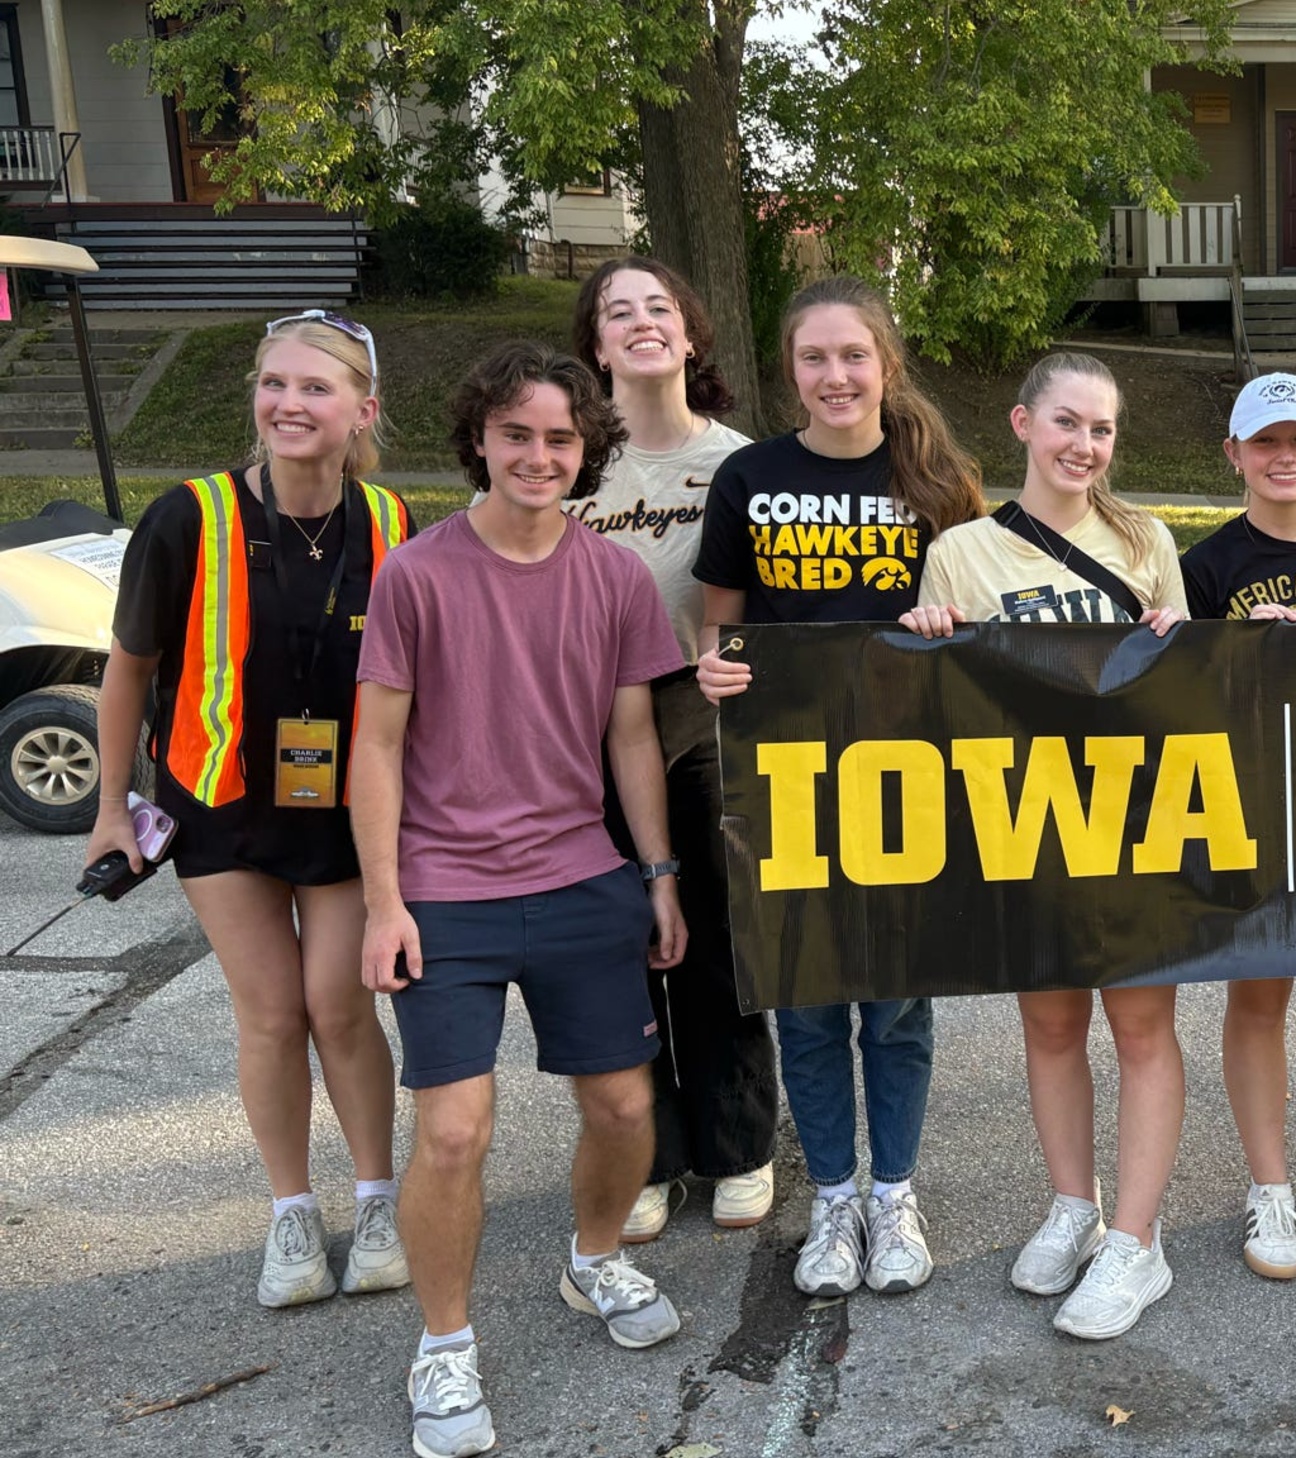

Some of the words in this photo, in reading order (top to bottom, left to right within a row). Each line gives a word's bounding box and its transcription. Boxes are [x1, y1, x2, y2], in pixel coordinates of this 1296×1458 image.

[748, 492, 850, 525] CORN
[860, 496, 918, 525] FED
[748, 524, 919, 559] HAWKEYE
[756, 556, 853, 590] BRED
[757, 732, 1258, 892] IOWA
